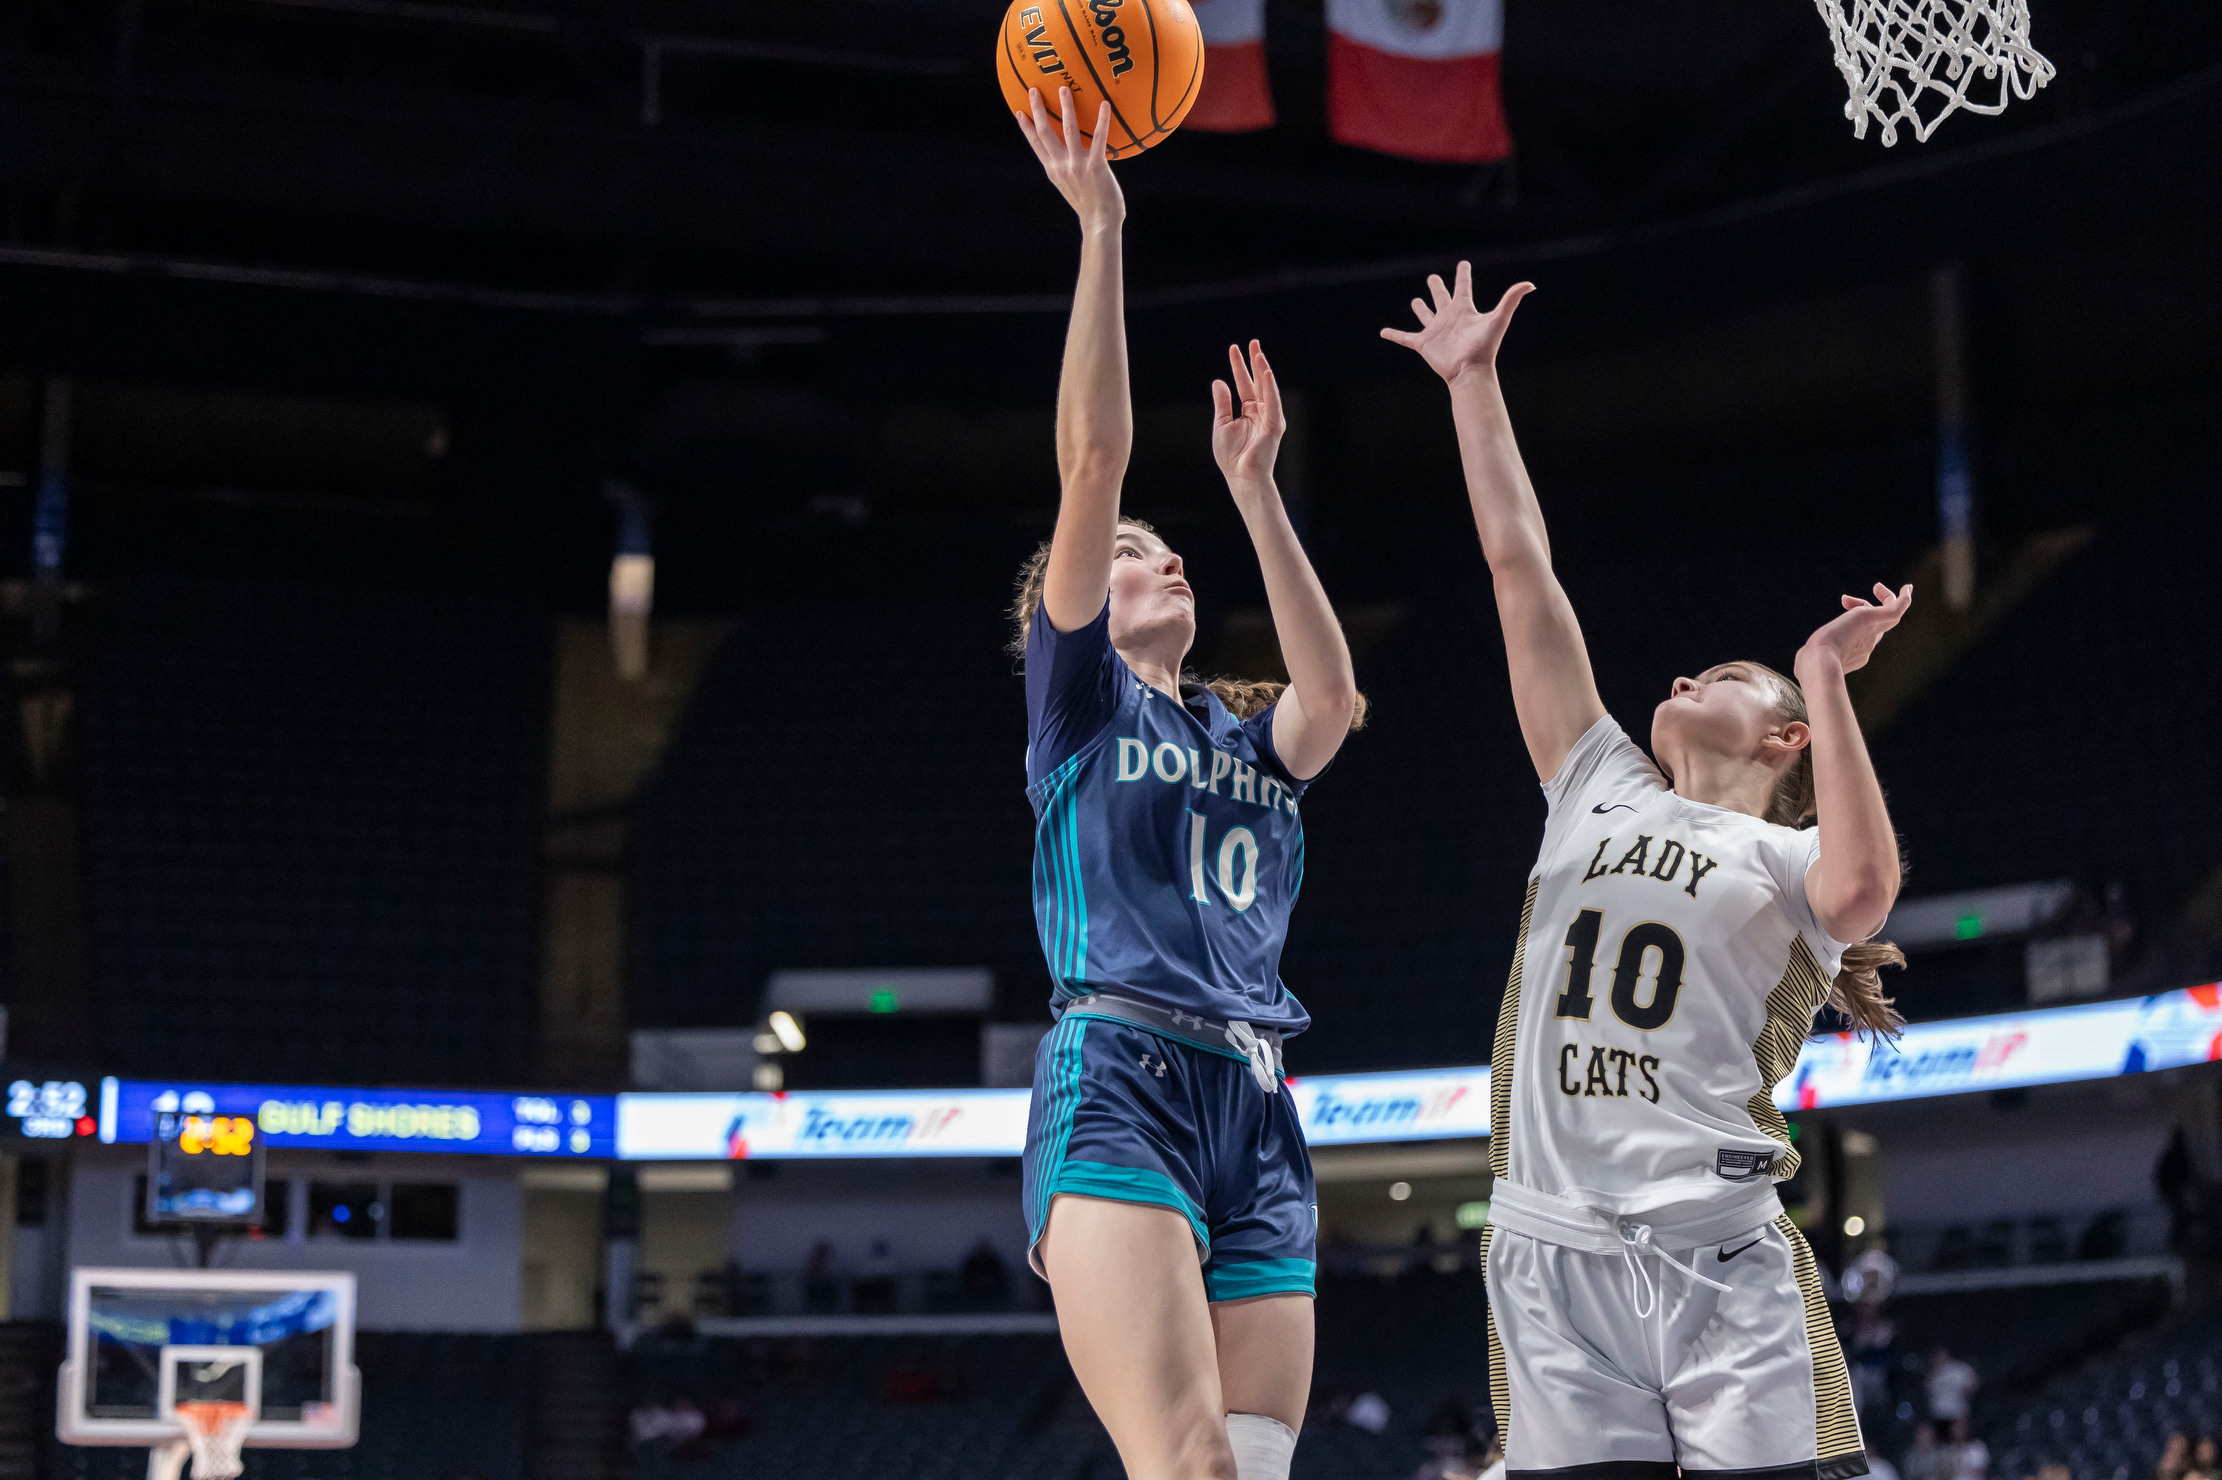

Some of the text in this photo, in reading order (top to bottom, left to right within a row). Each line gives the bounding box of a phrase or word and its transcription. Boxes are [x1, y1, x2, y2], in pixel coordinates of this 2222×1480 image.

[1019, 5, 1084, 92] EVO NXT
[1185, 807, 1260, 914] 10
[1581, 833, 1719, 900] LADY
[1553, 905, 1687, 1033] 10
[1557, 1042, 1661, 1105] CATS
[258, 1100, 480, 1140] GULF SHORES
[1757, 1160, 1768, 1171] M
